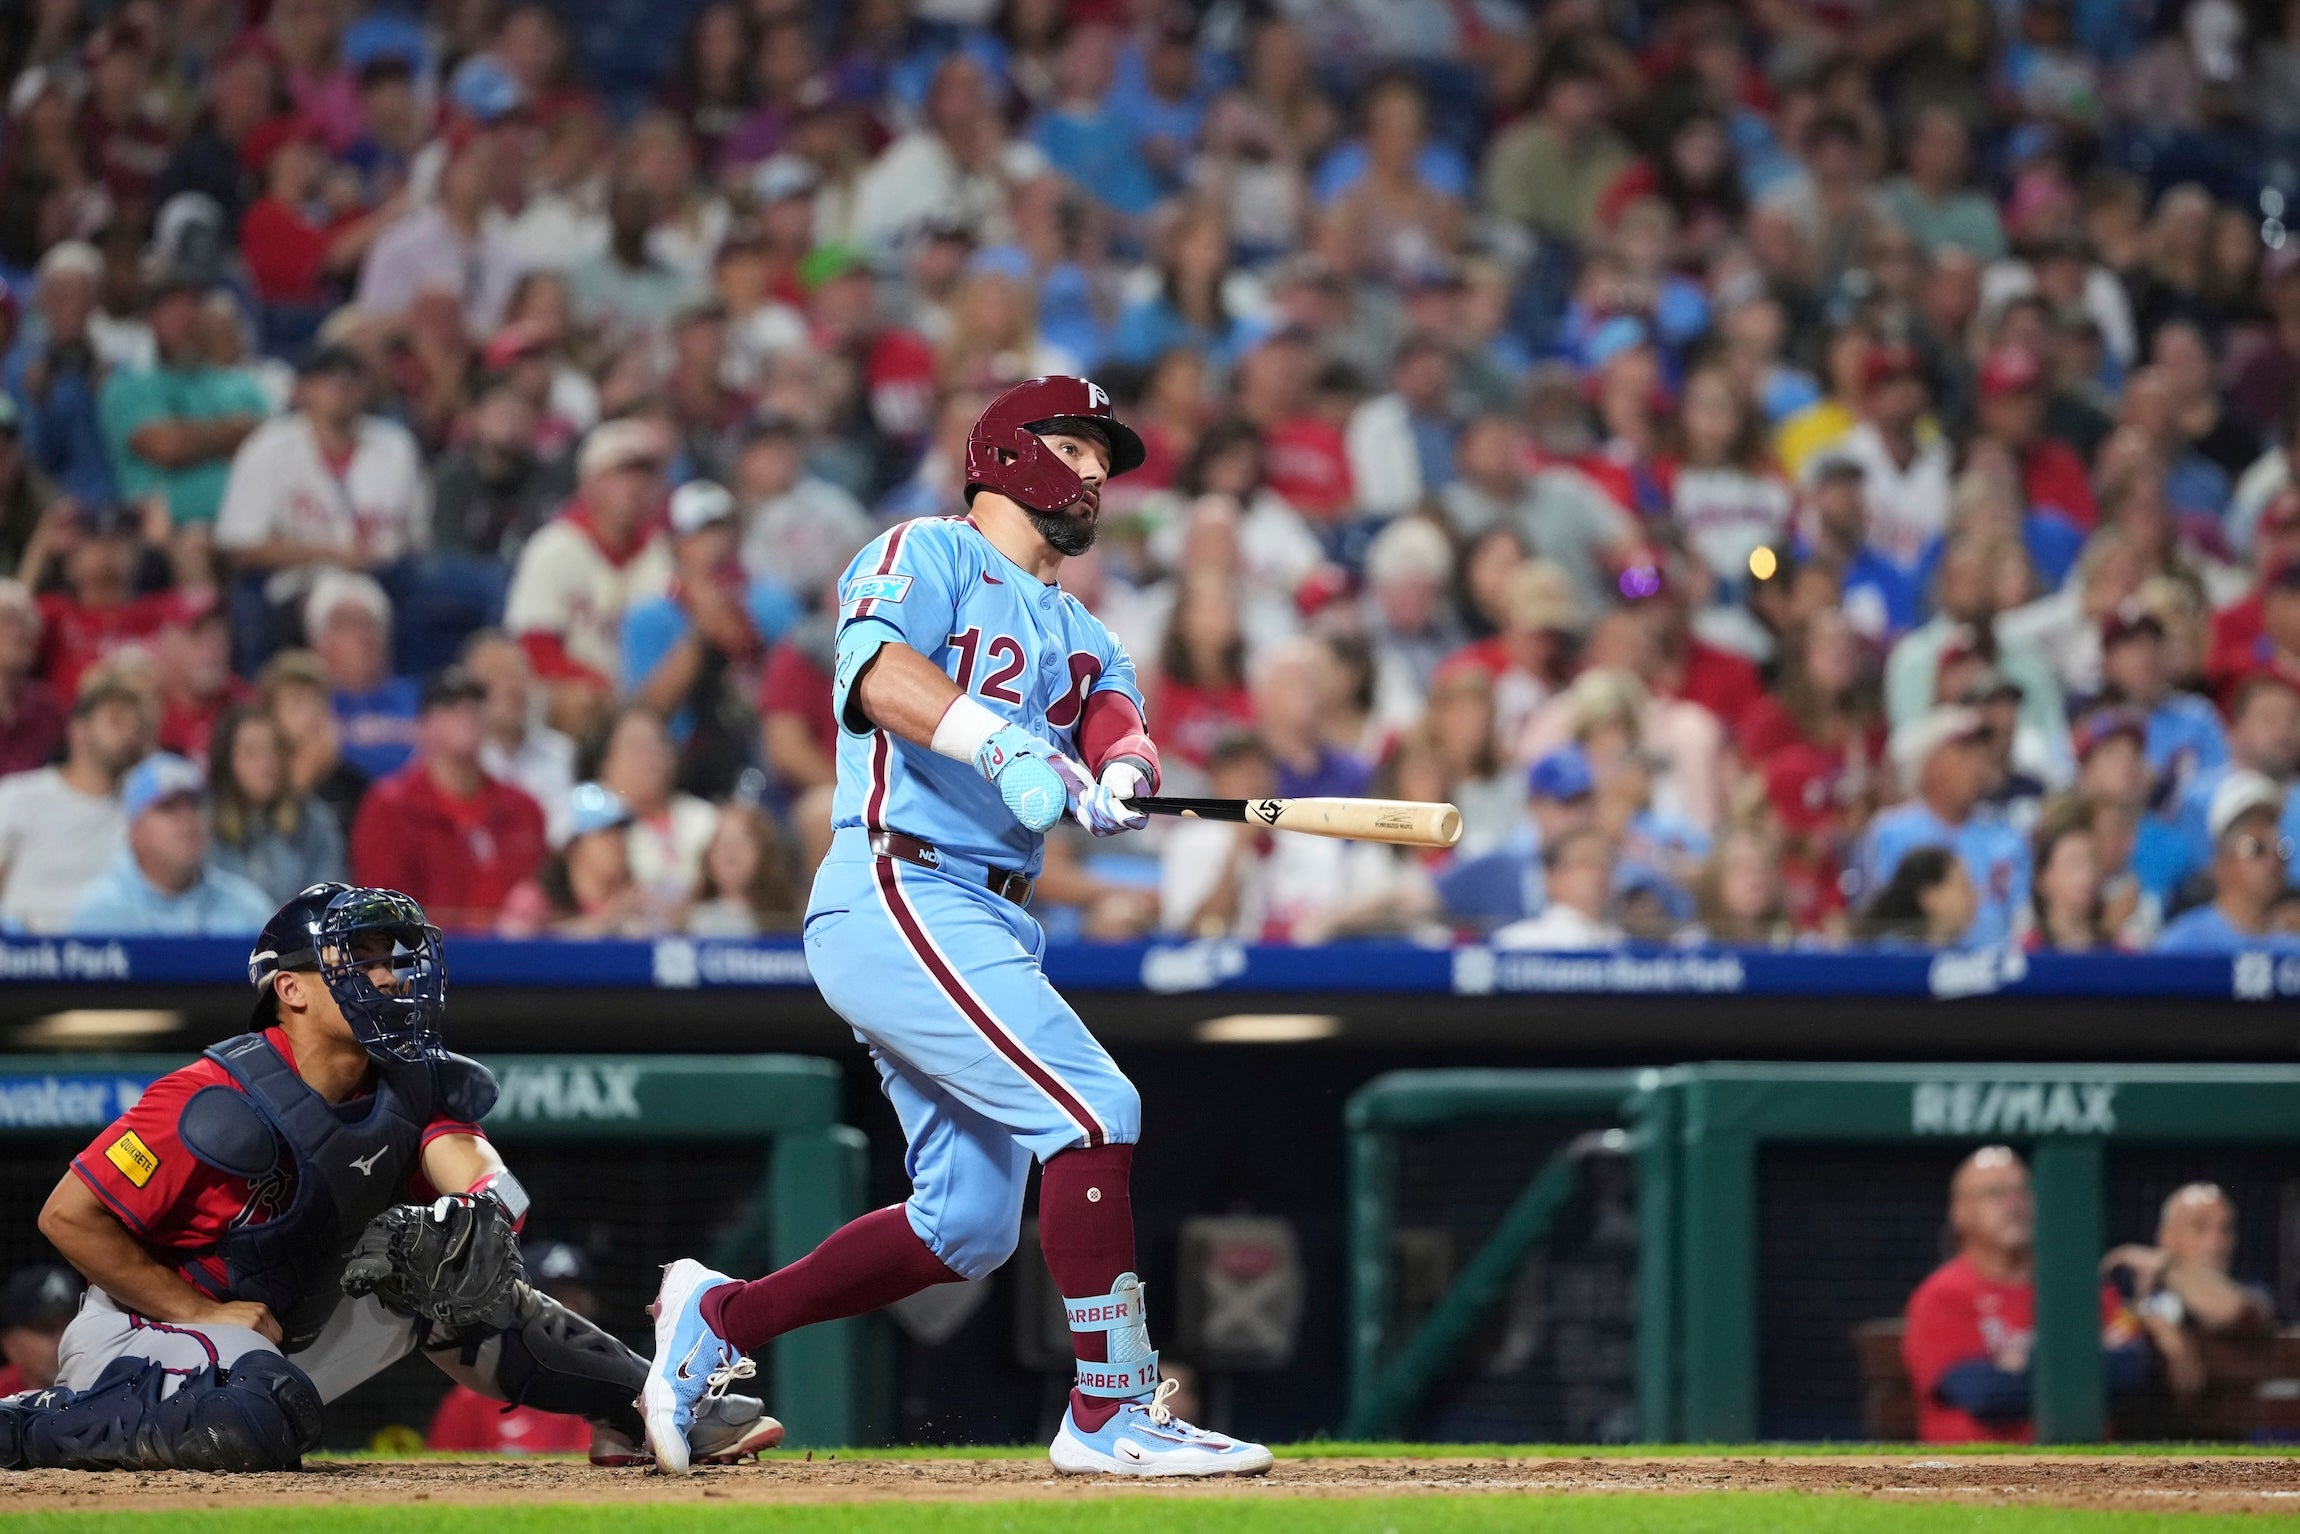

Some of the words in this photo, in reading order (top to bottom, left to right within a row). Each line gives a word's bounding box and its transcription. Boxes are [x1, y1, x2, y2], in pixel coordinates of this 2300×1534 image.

[946, 626, 1028, 708] 12
[700, 947, 815, 984] Citizen
[490, 1065, 641, 1121] /MAX
[1911, 1081, 2118, 1134] RE/MAX
[120, 1138, 152, 1172] QUIKRETE
[1067, 1303, 1128, 1323] ARBER
[1077, 1371, 1129, 1389] ARBER
[1138, 1363, 1155, 1386] 12
